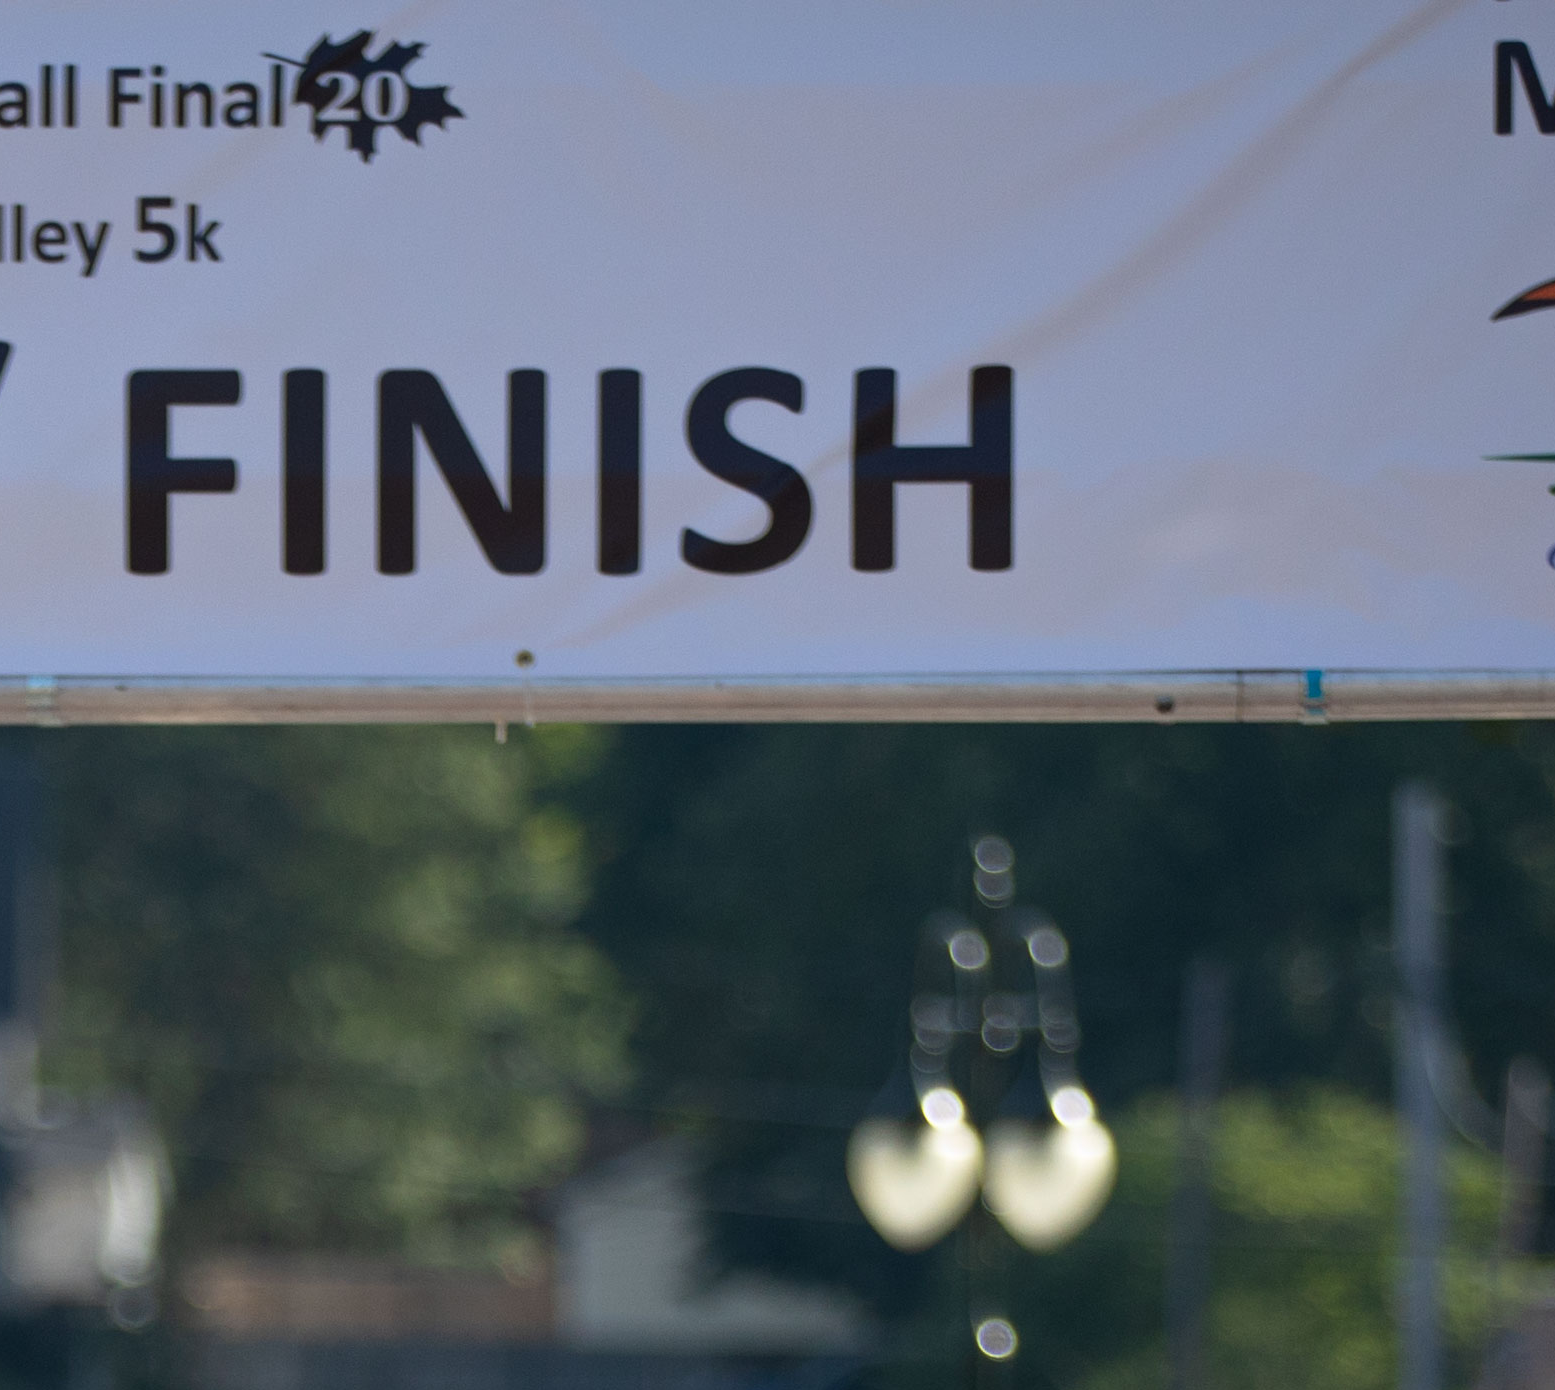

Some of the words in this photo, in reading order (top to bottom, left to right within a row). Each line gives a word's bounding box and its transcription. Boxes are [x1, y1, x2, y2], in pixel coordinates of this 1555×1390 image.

[107, 64, 285, 129] Final
[313, 68, 411, 127] 20
[133, 197, 222, 263] 5k
[123, 364, 1015, 577] FINISH
